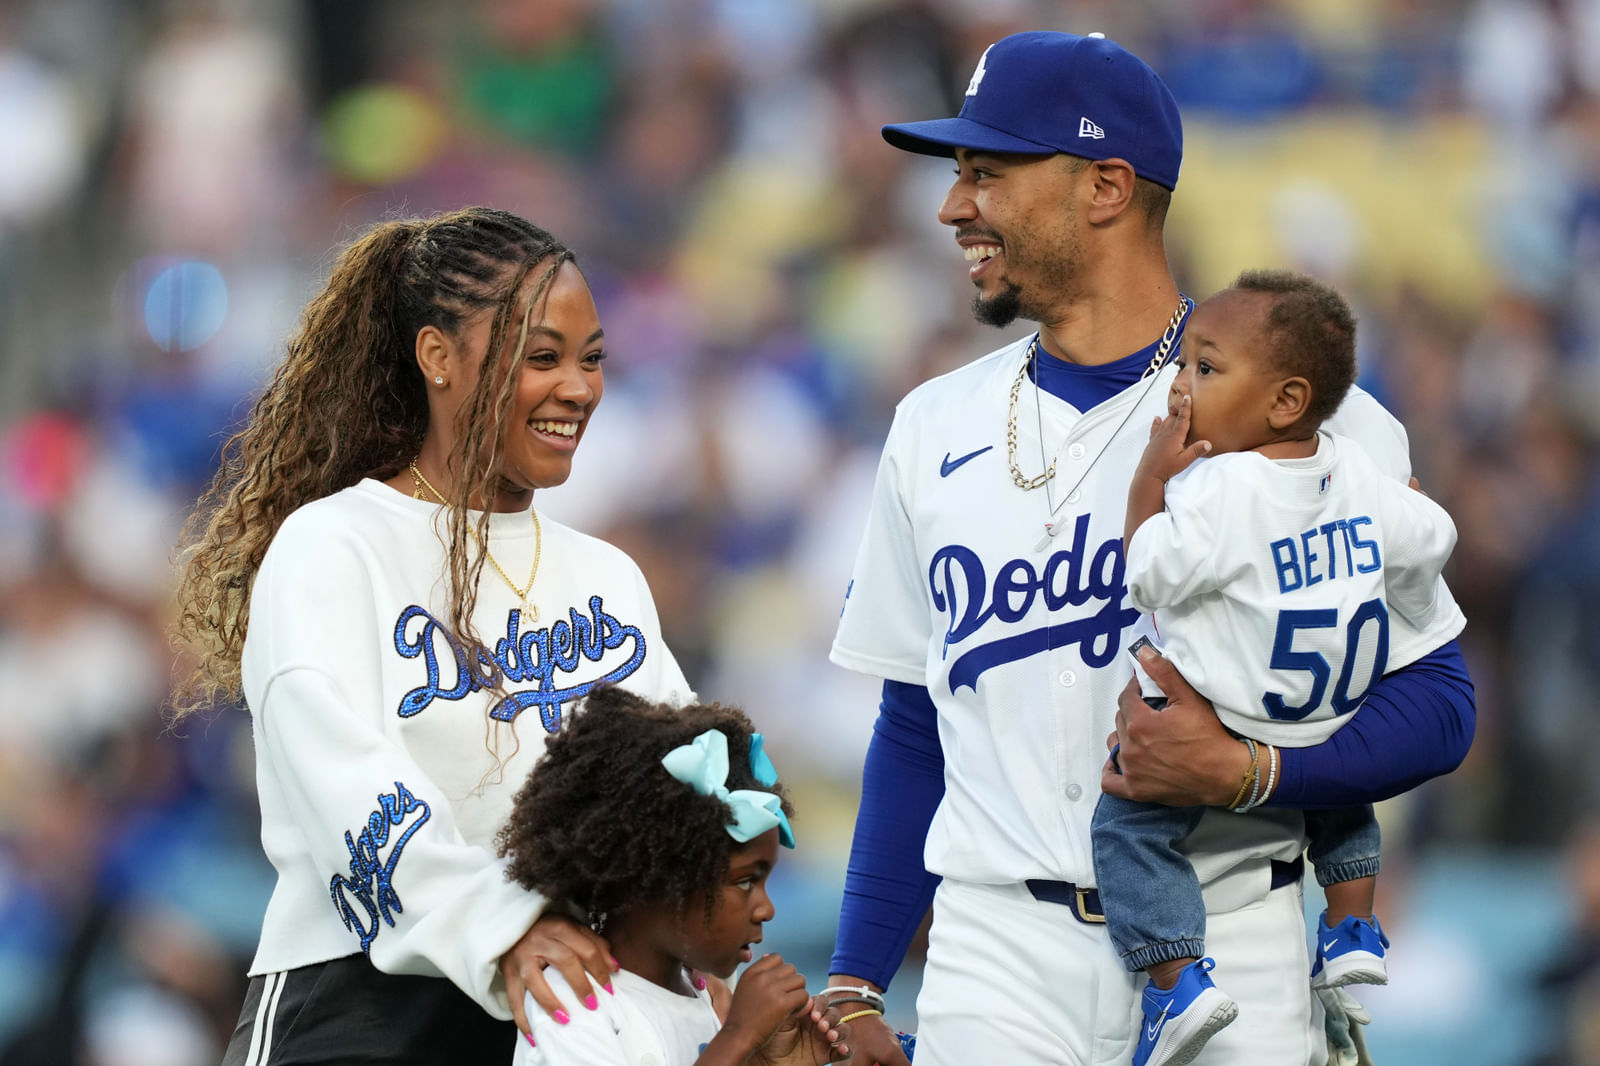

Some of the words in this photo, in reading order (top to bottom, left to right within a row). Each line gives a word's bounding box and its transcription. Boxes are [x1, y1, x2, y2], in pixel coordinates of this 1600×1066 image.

[929, 513, 1141, 696] Dodg
[1270, 515, 1382, 594] BETTS
[394, 595, 647, 733] Dodgers
[1262, 597, 1390, 722] 50
